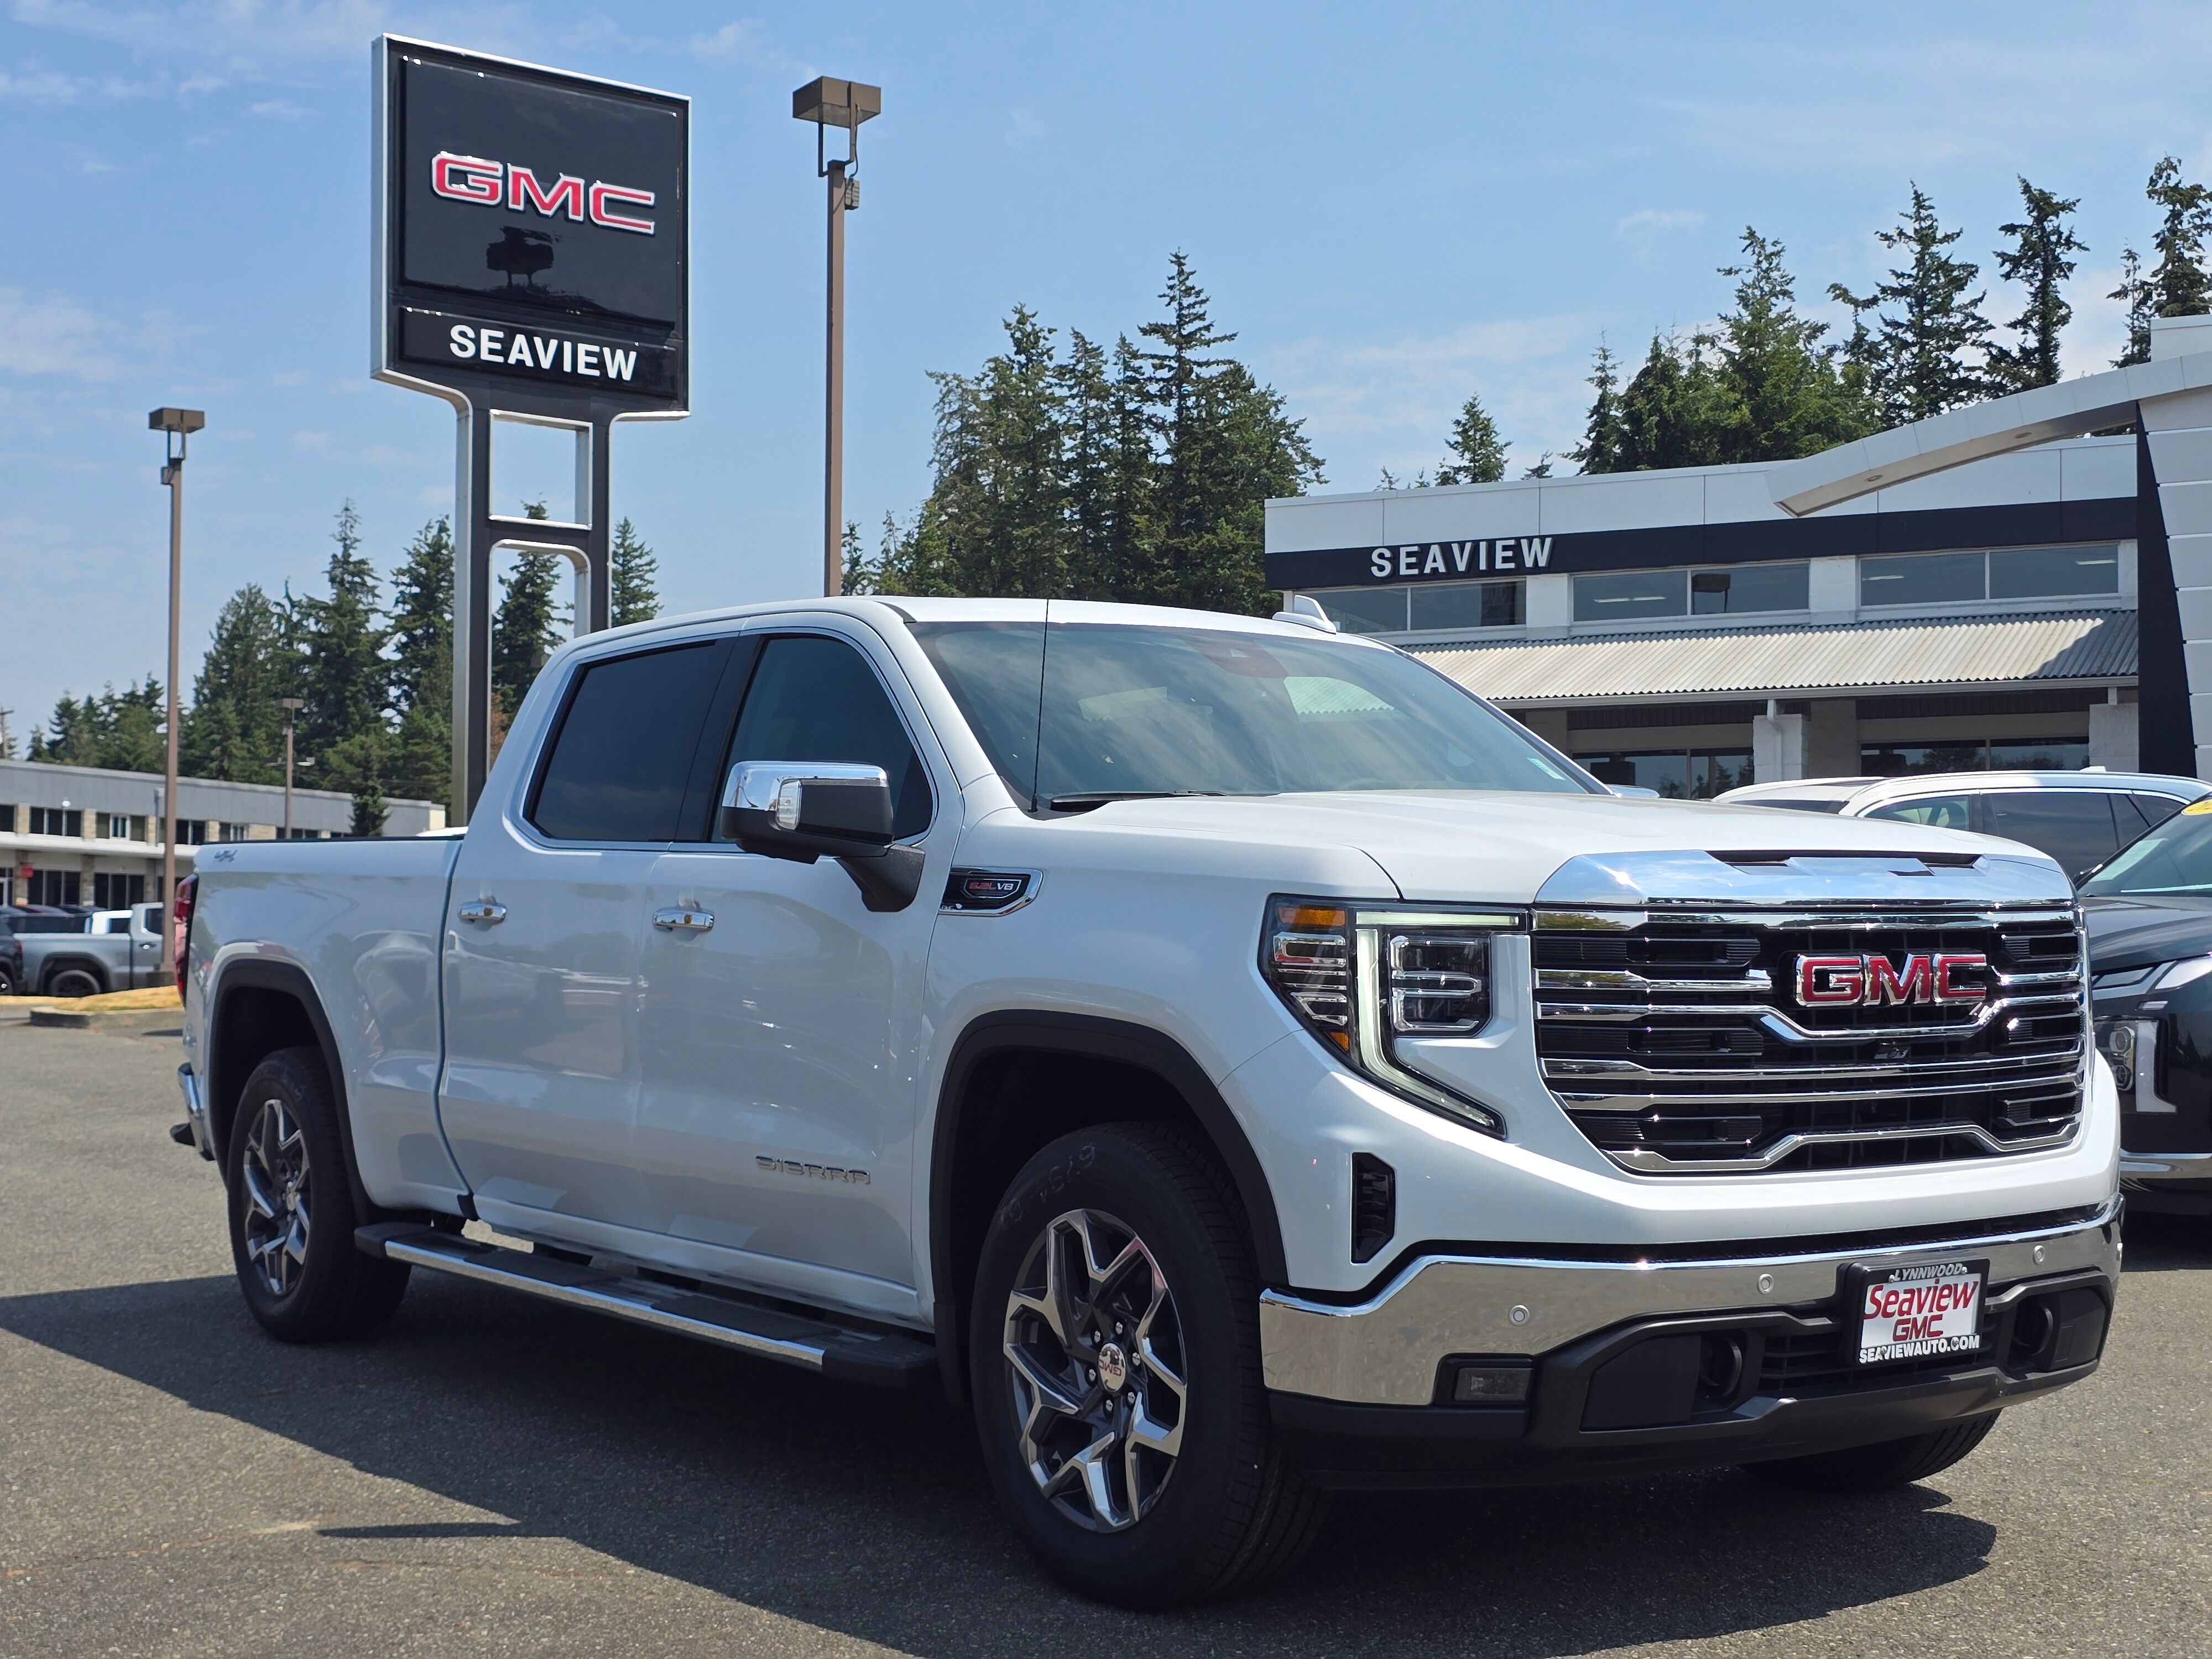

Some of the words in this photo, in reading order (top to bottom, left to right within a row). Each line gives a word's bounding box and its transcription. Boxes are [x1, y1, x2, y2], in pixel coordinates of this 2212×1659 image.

[432, 151, 655, 234] GMC
[450, 325, 637, 381] SEAVIEW
[1371, 538, 1552, 577] SEAVIEW
[1796, 953, 1986, 1006] GMC
[755, 1156, 871, 1185] SIERRA
[1893, 1263, 1963, 1281] LYNNWOOD
[1864, 1279, 1979, 1319] Seaview
[1892, 1314, 1943, 1342] GMC
[1859, 1335, 1980, 1364] SEAVIEWAUTO.COM
[1099, 1359, 1121, 1376] GMC
